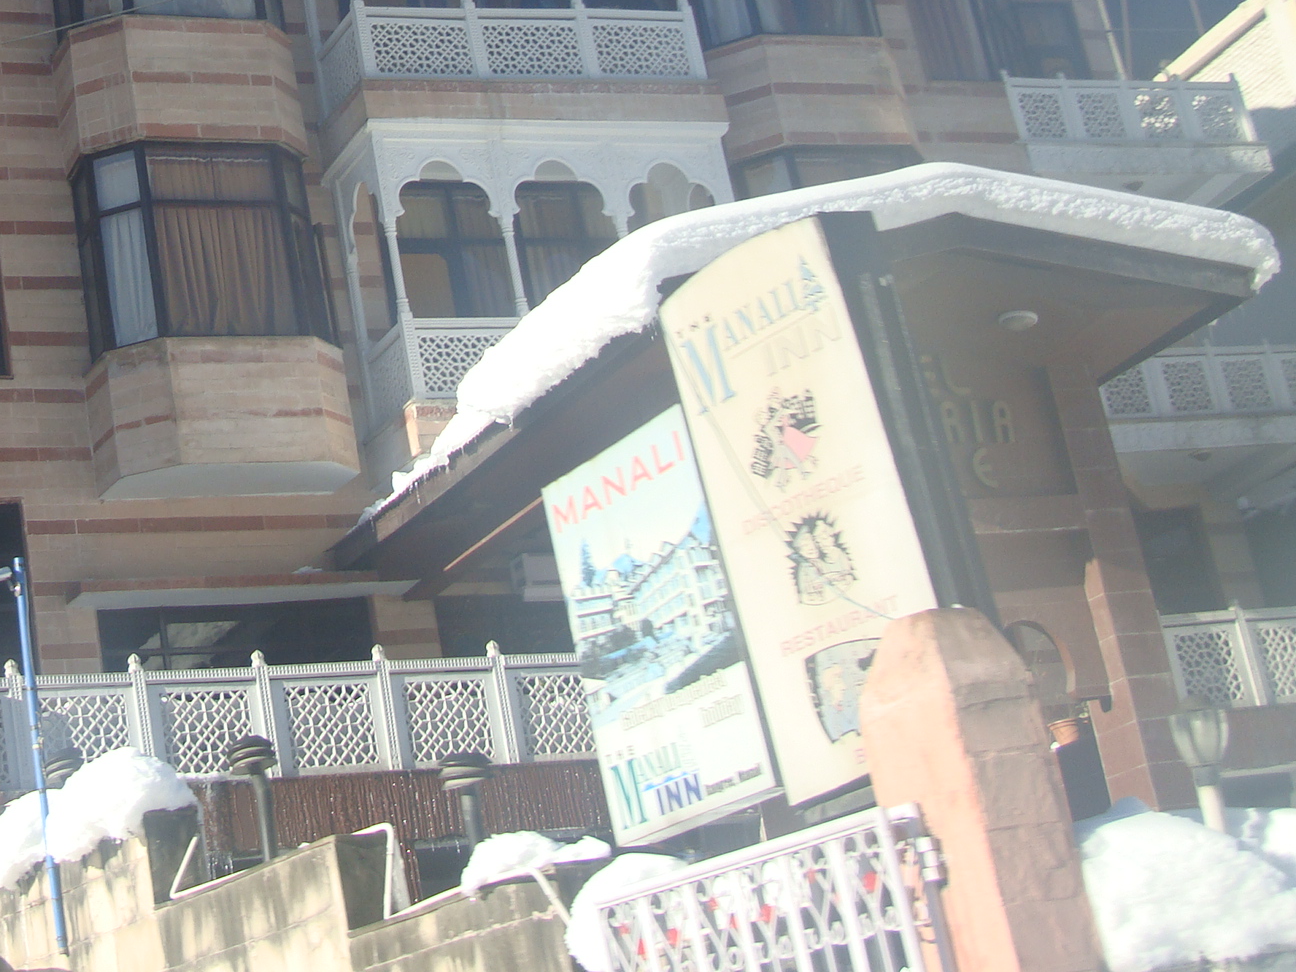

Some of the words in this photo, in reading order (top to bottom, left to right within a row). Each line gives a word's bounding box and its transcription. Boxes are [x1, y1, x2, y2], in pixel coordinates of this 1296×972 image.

[680, 280, 803, 416] MANALI
[764, 302, 843, 377] INN
[551, 430, 686, 533] MANALI
[780, 594, 898, 658] RESTAURANT
[609, 741, 682, 830] MANALI
[655, 772, 703, 816] INN
